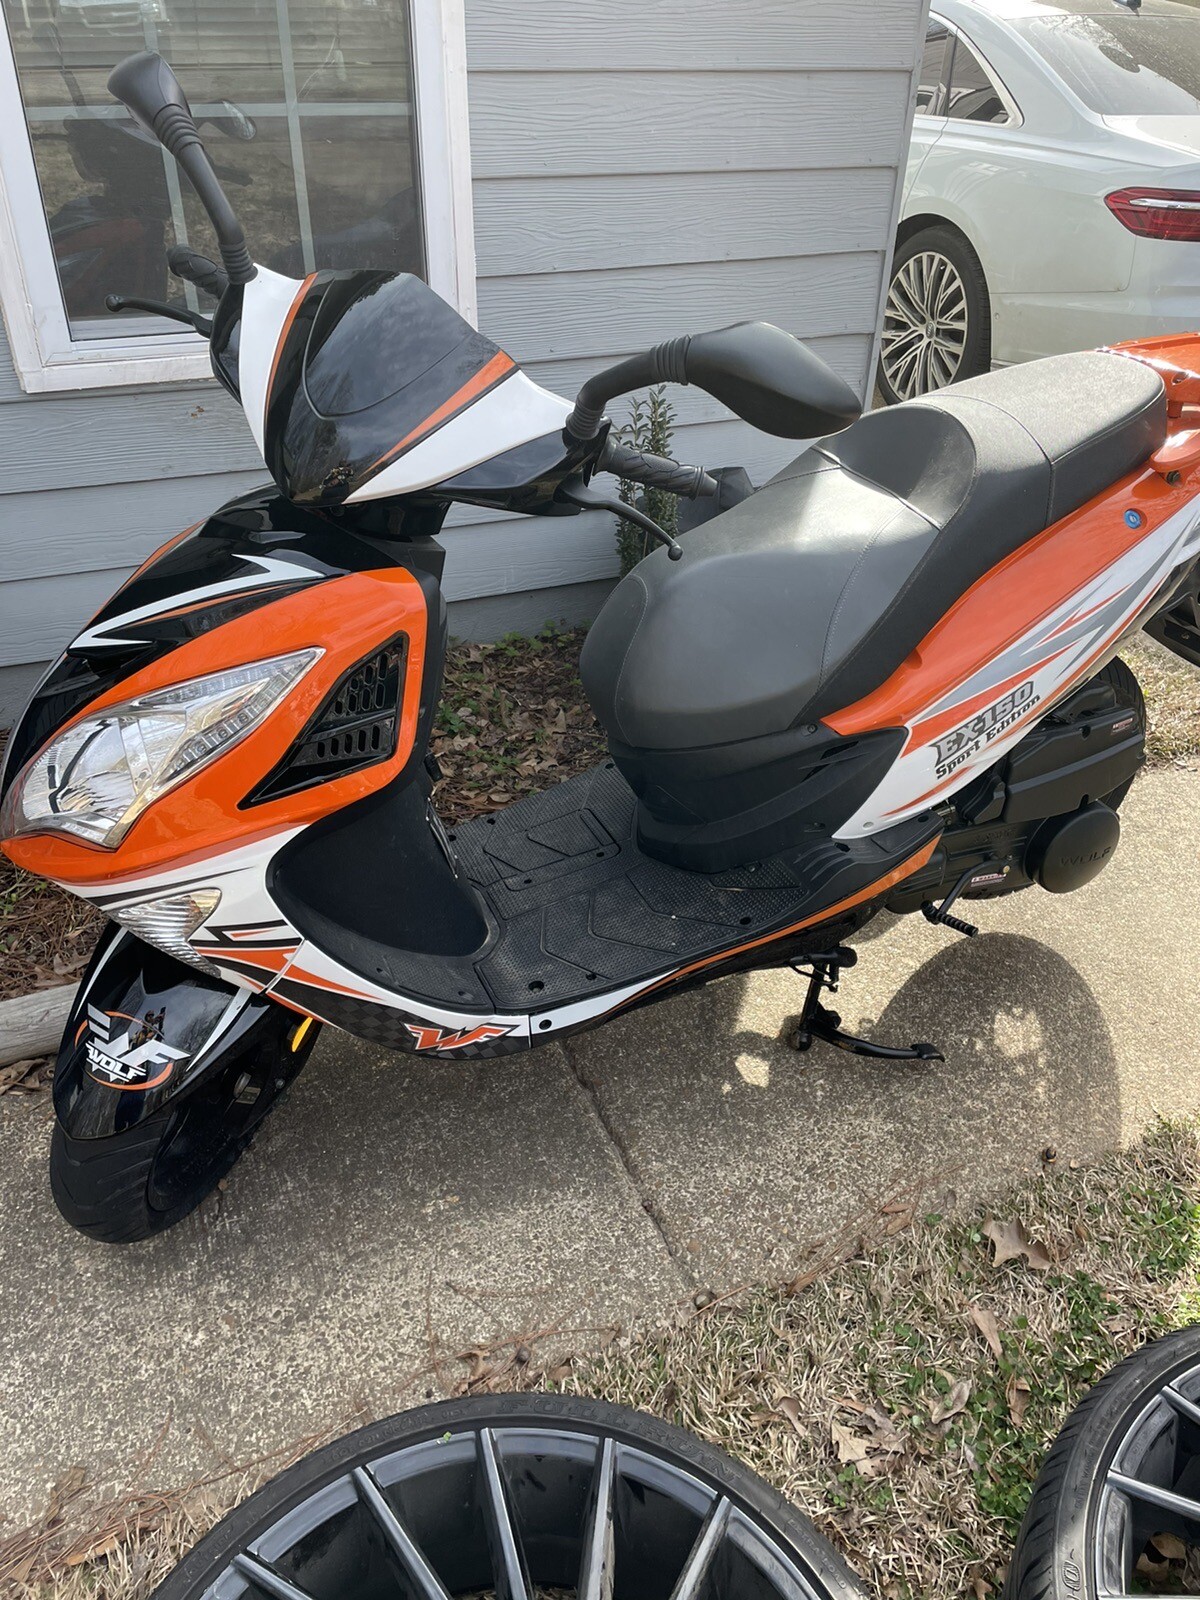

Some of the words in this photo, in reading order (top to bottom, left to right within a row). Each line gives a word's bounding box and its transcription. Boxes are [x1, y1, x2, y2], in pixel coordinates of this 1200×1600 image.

[935, 740, 981, 780] Sport
[985, 694, 1041, 743] Edition
[1059, 846, 1111, 867] WOLF
[85, 1042, 147, 1081] WOLF
